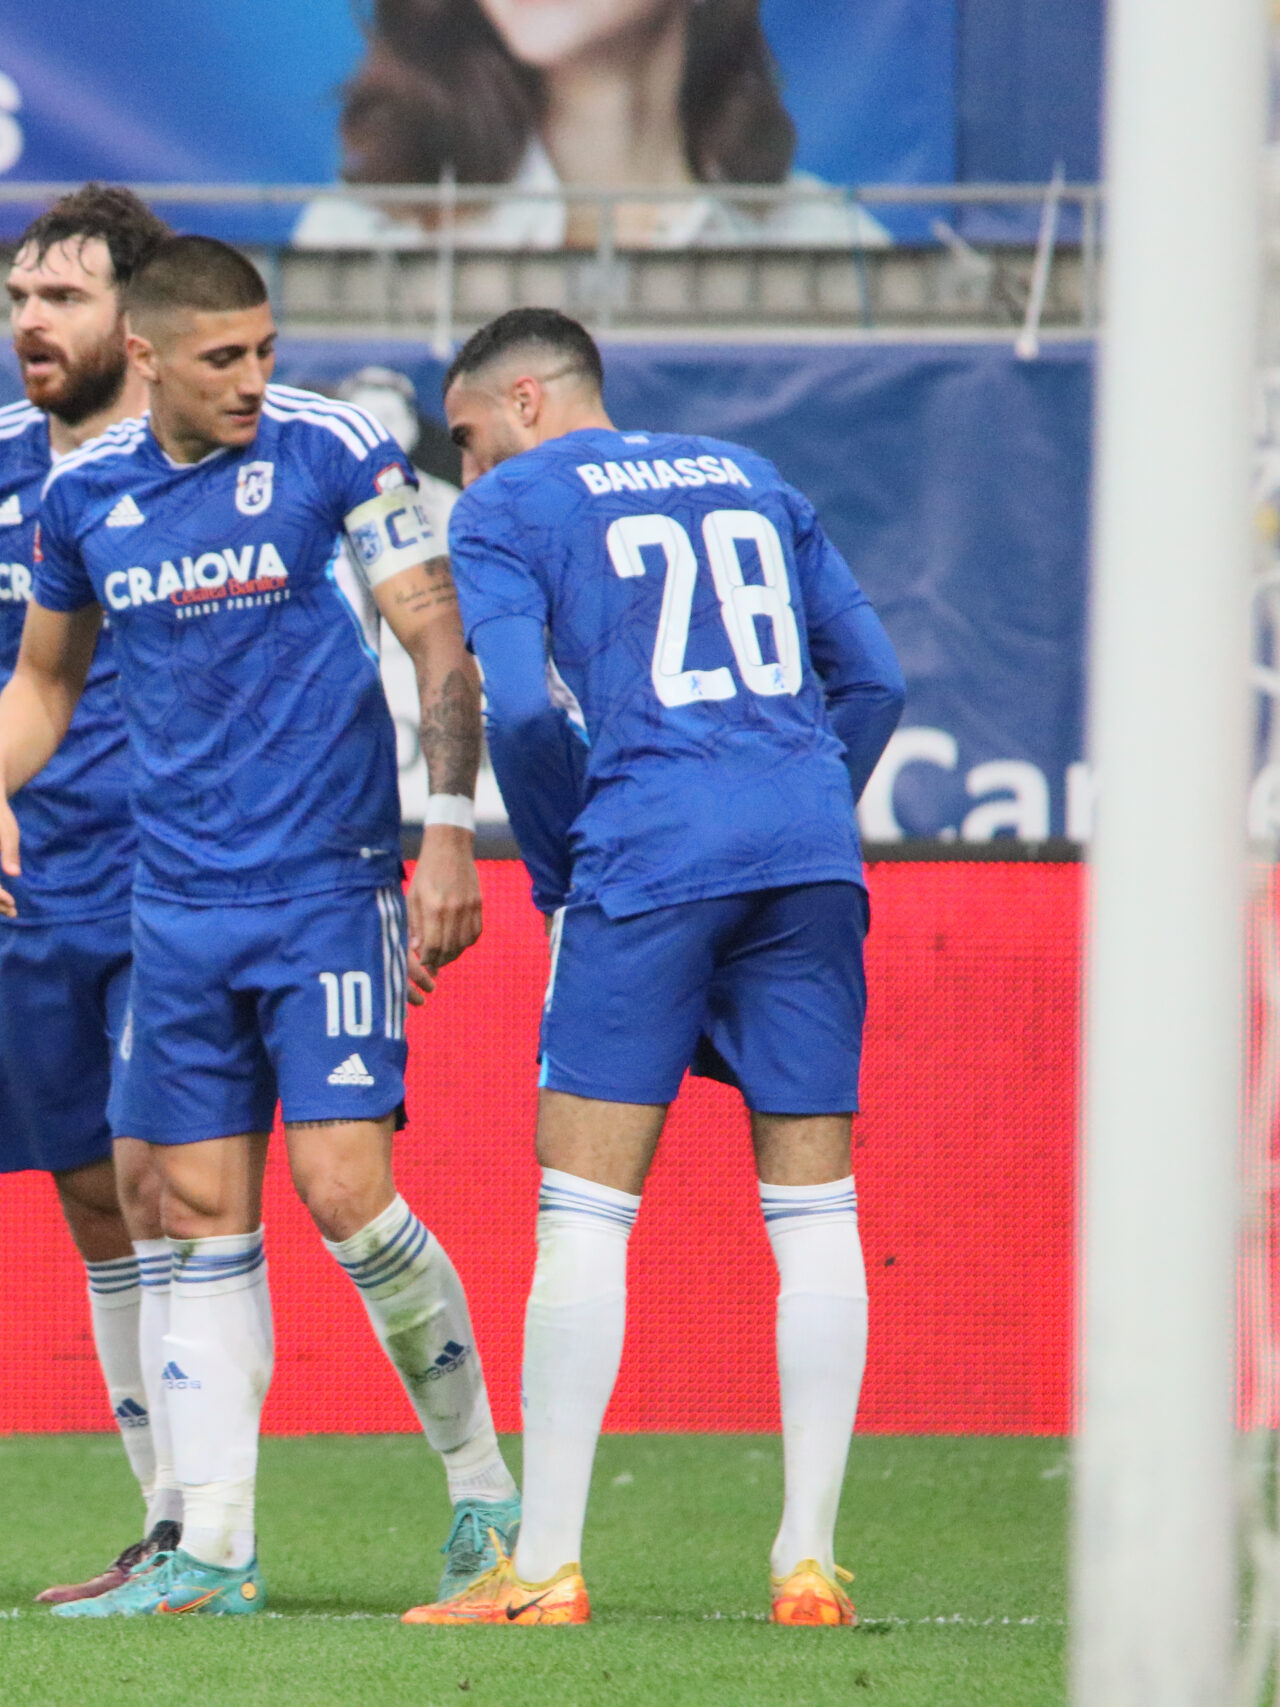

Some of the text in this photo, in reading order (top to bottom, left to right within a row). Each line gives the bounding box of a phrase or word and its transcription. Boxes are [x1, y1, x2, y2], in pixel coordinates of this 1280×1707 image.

[576, 455, 752, 495] BAHASSA
[104, 543, 288, 611] CRAIOVA
[606, 509, 803, 708] 28
[320, 971, 373, 1037] 10
